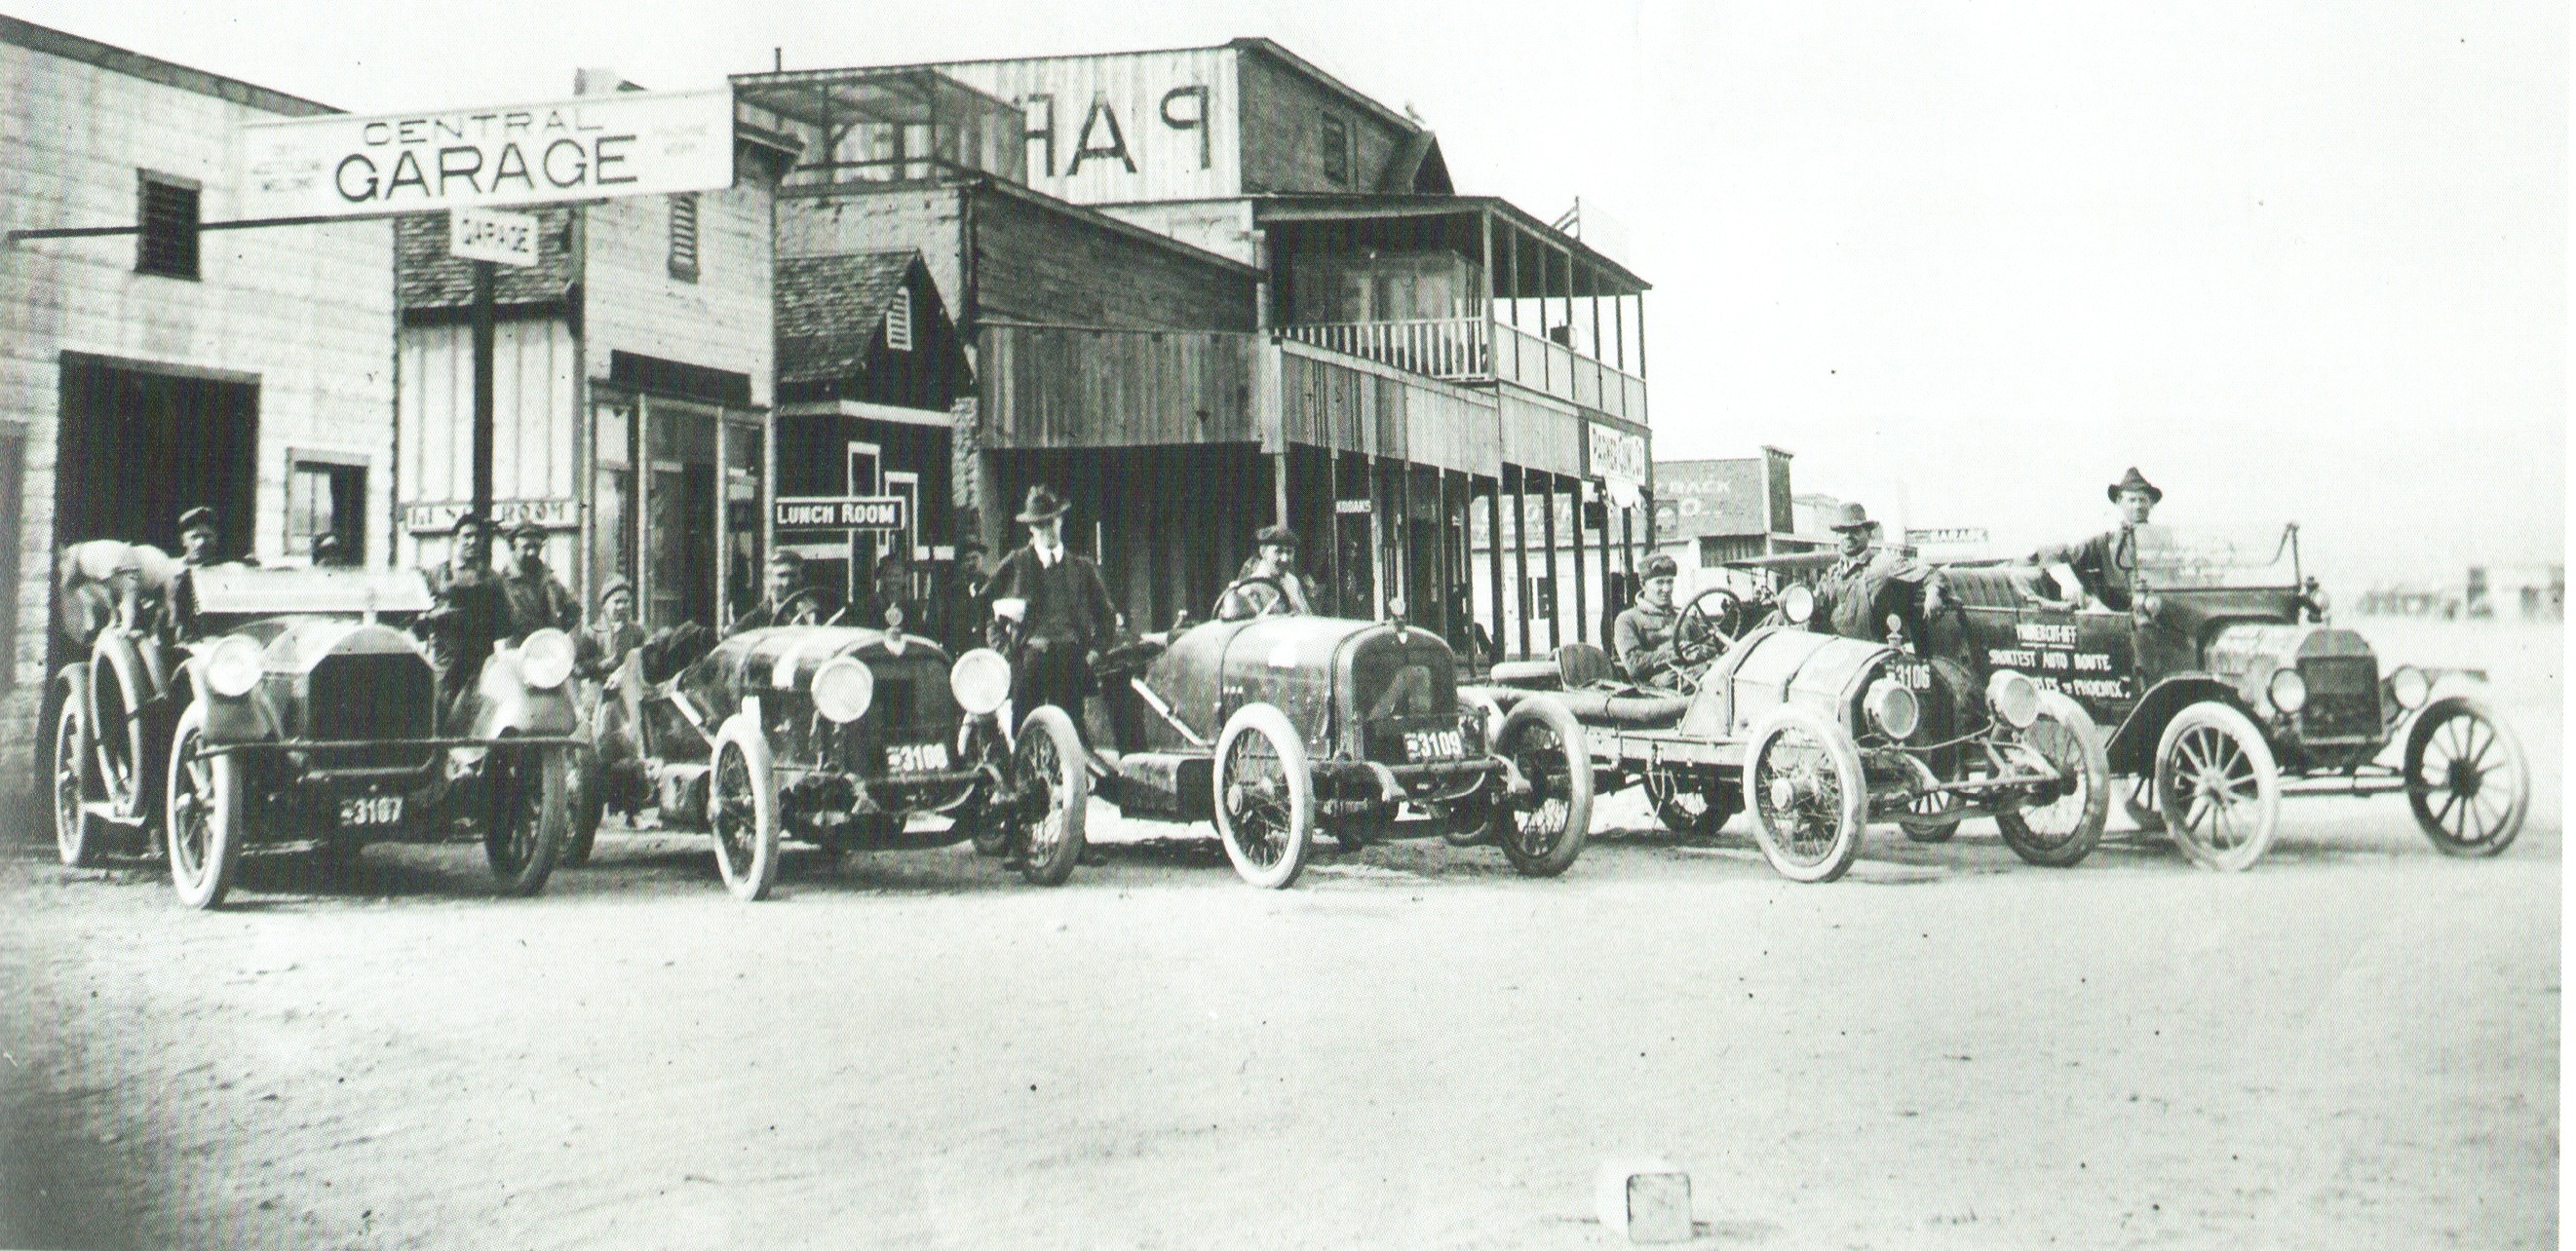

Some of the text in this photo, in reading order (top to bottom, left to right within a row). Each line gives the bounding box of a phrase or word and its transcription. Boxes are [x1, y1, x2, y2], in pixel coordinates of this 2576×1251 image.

[364, 108, 604, 146] CENTRAL
[336, 134, 637, 202] GARAGE
[777, 504, 896, 524] LUNCH ROOM
[1988, 649, 2036, 667] SHORTEST
[2043, 652, 2068, 669] AUTO
[1896, 663, 1931, 689] 3106
[1417, 730, 1463, 758] 3109
[353, 797, 403, 825] 3107
